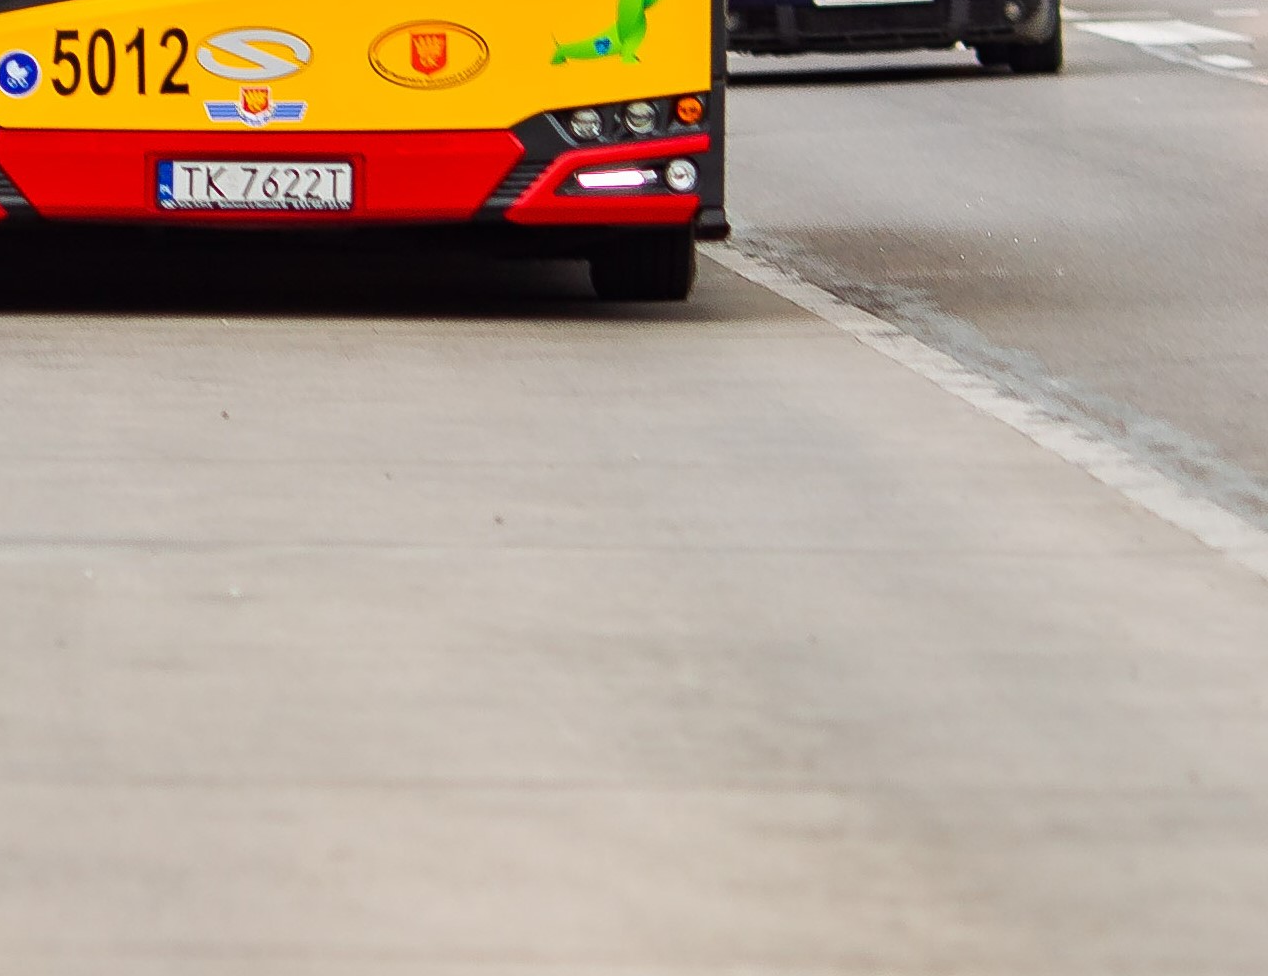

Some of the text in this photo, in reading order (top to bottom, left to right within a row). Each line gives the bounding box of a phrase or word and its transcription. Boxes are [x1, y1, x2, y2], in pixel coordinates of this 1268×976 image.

[51, 27, 189, 96] 5012
[181, 165, 345, 202] TK 7622T
